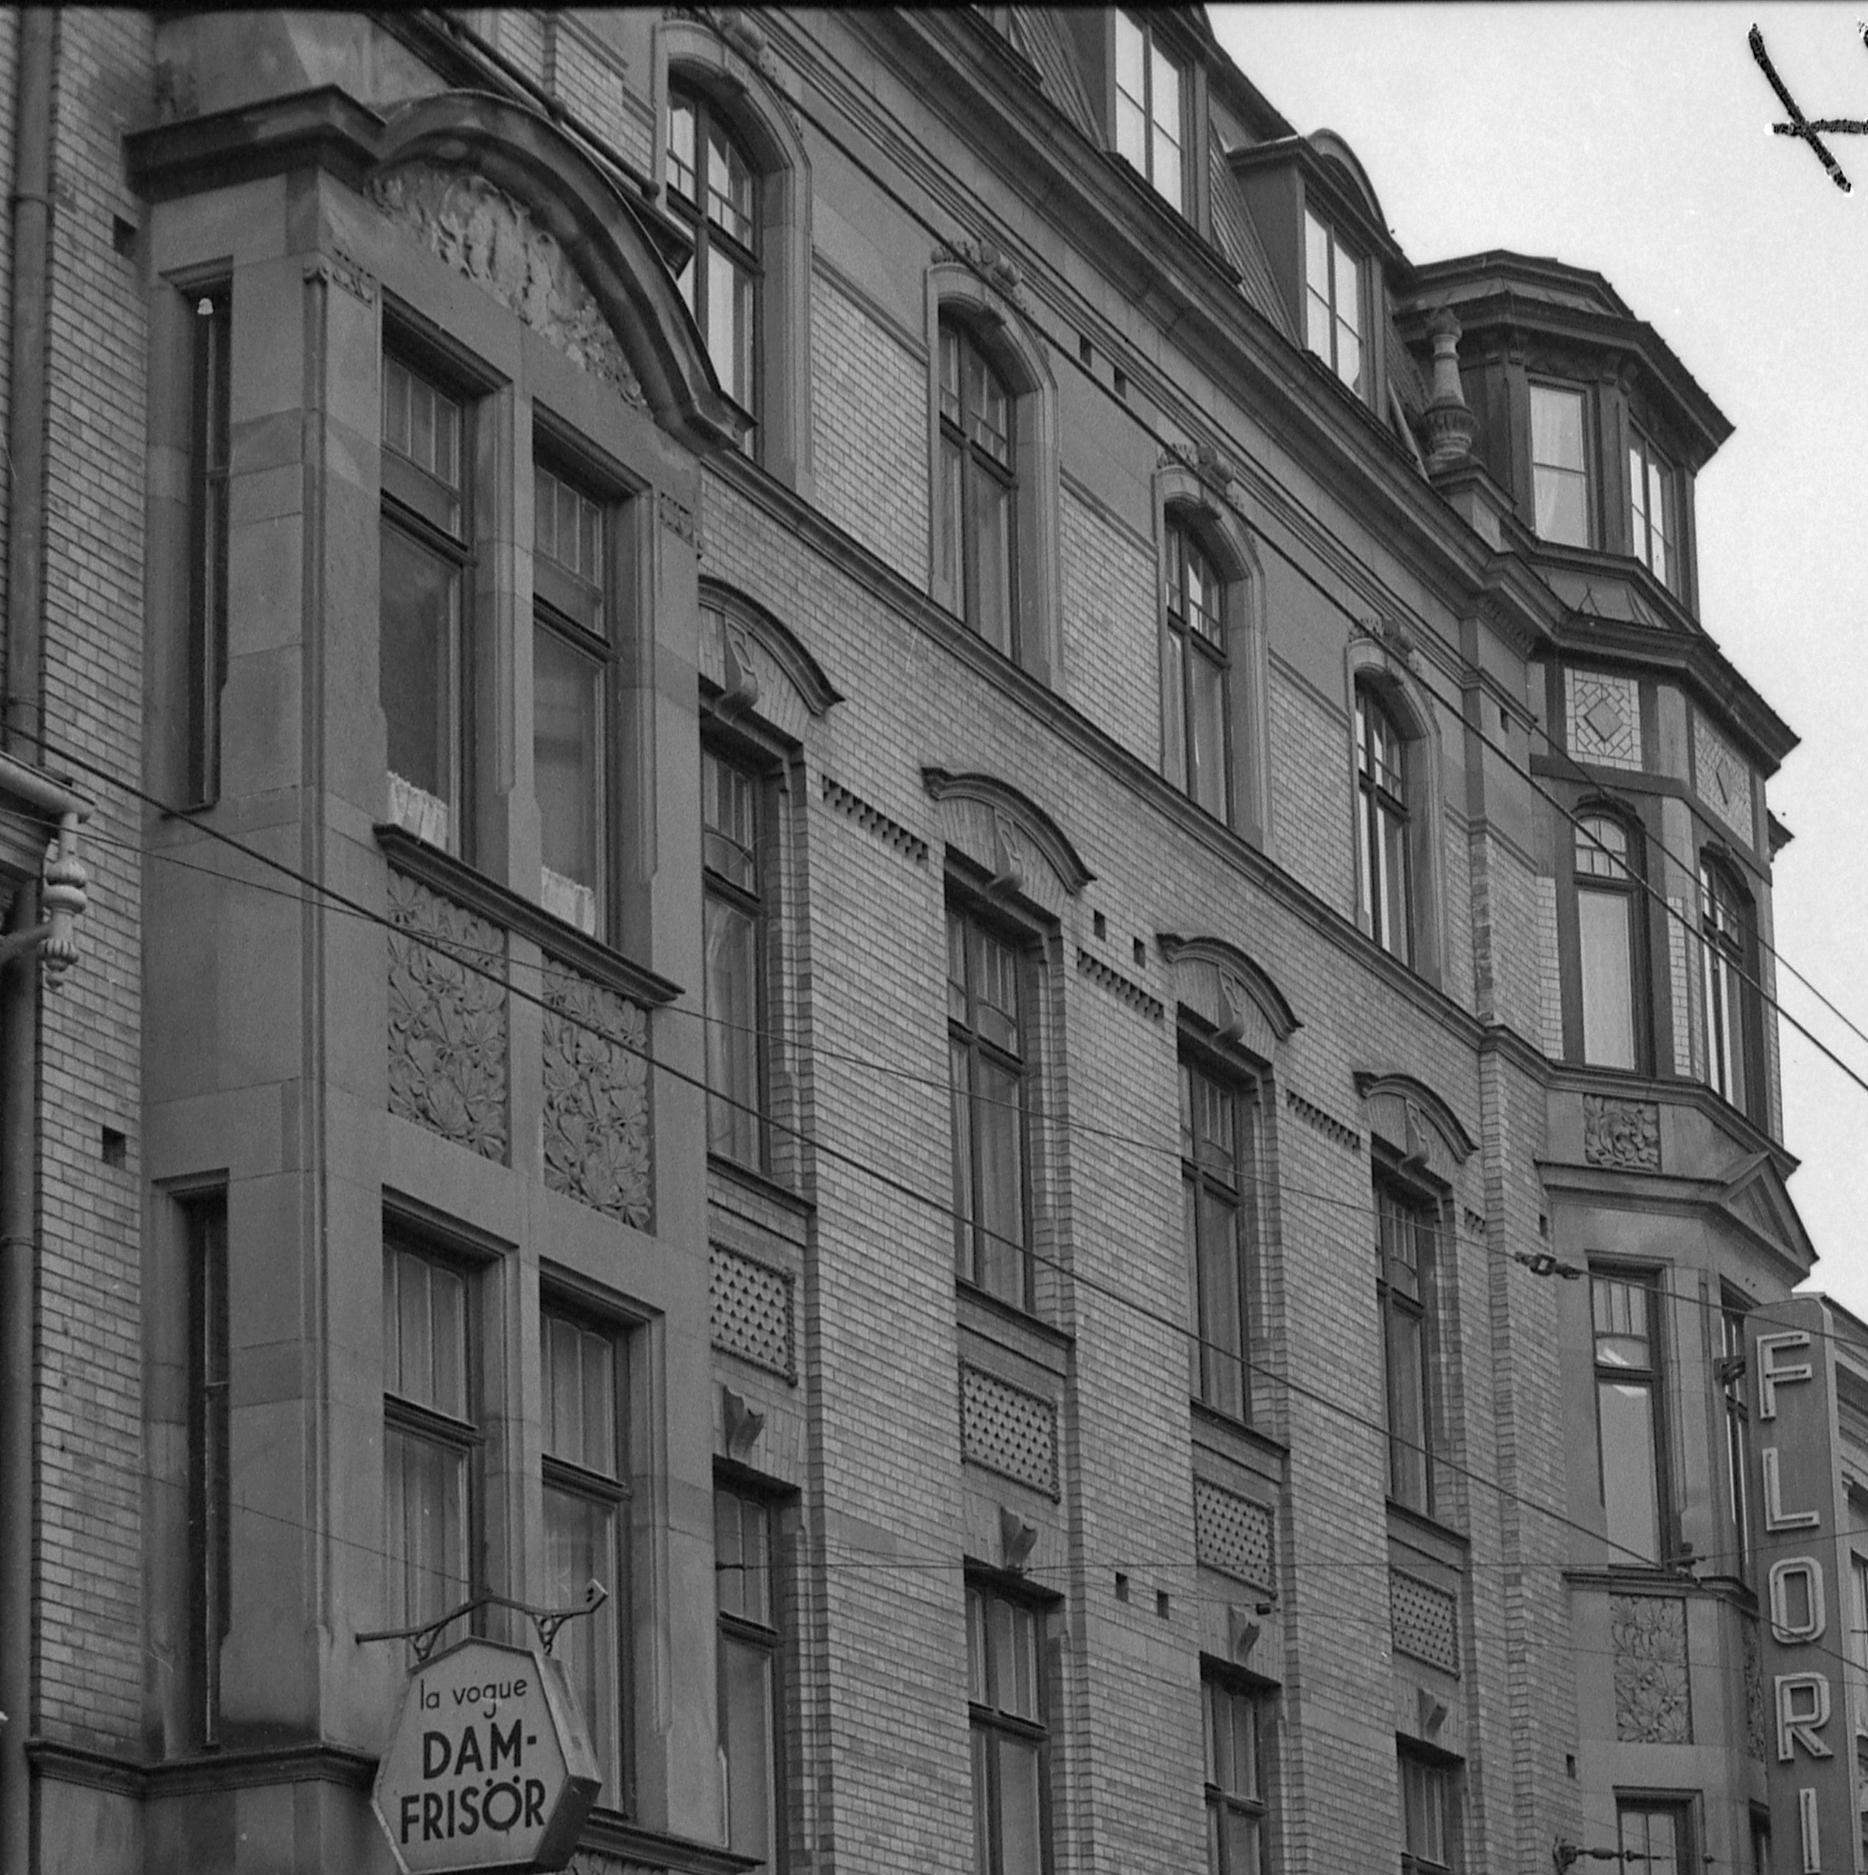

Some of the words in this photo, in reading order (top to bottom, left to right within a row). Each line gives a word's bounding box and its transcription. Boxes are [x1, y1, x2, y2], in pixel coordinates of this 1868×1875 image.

[420, 1679, 441, 1710] la
[453, 1678, 528, 1719] vogue
[422, 1718, 538, 1781] DAM-
[400, 1774, 547, 1845] FRISÖR
